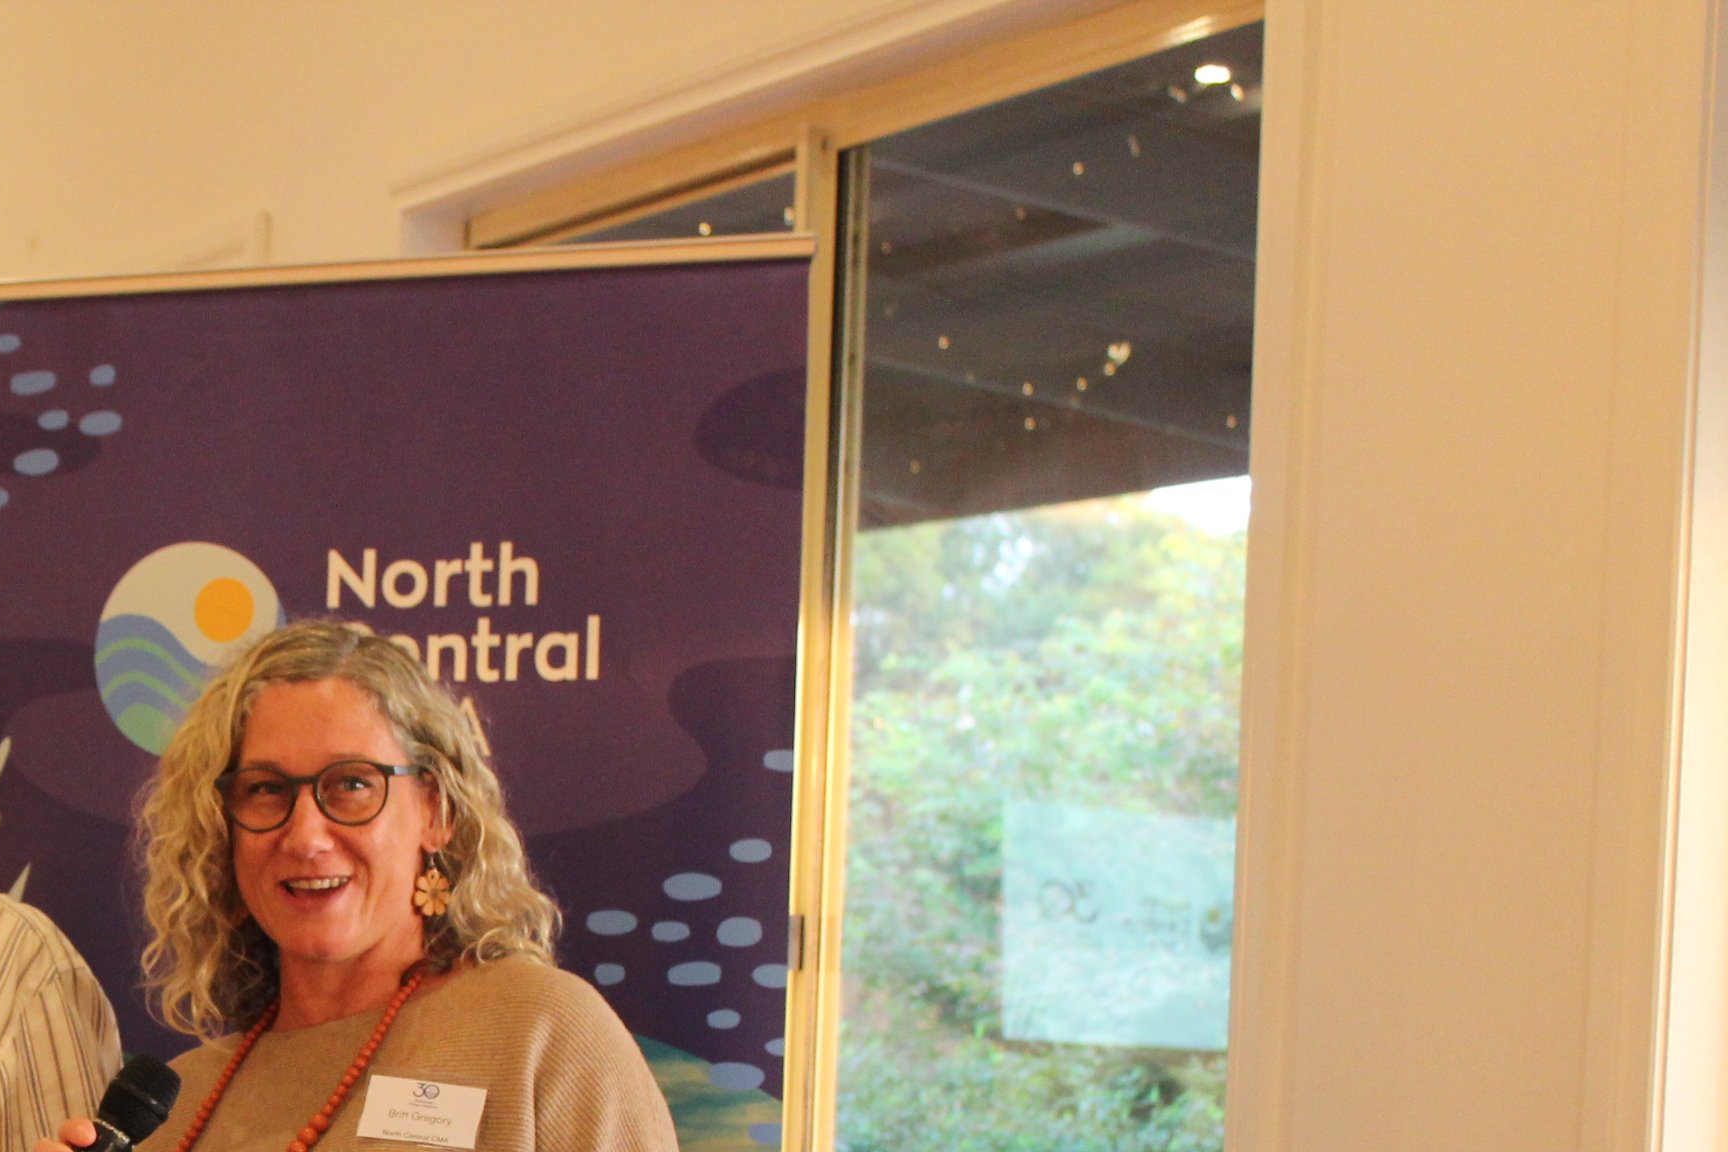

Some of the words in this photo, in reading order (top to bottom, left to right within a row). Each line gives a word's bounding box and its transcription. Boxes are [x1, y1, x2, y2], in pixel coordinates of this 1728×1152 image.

[326, 541, 540, 609] North
[342, 614, 601, 683] ntral
[413, 1082, 440, 1099] 30
[388, 1108, 409, 1120] Britt
[411, 1111, 452, 1127] Gregory
[430, 1134, 449, 1143] CMA
